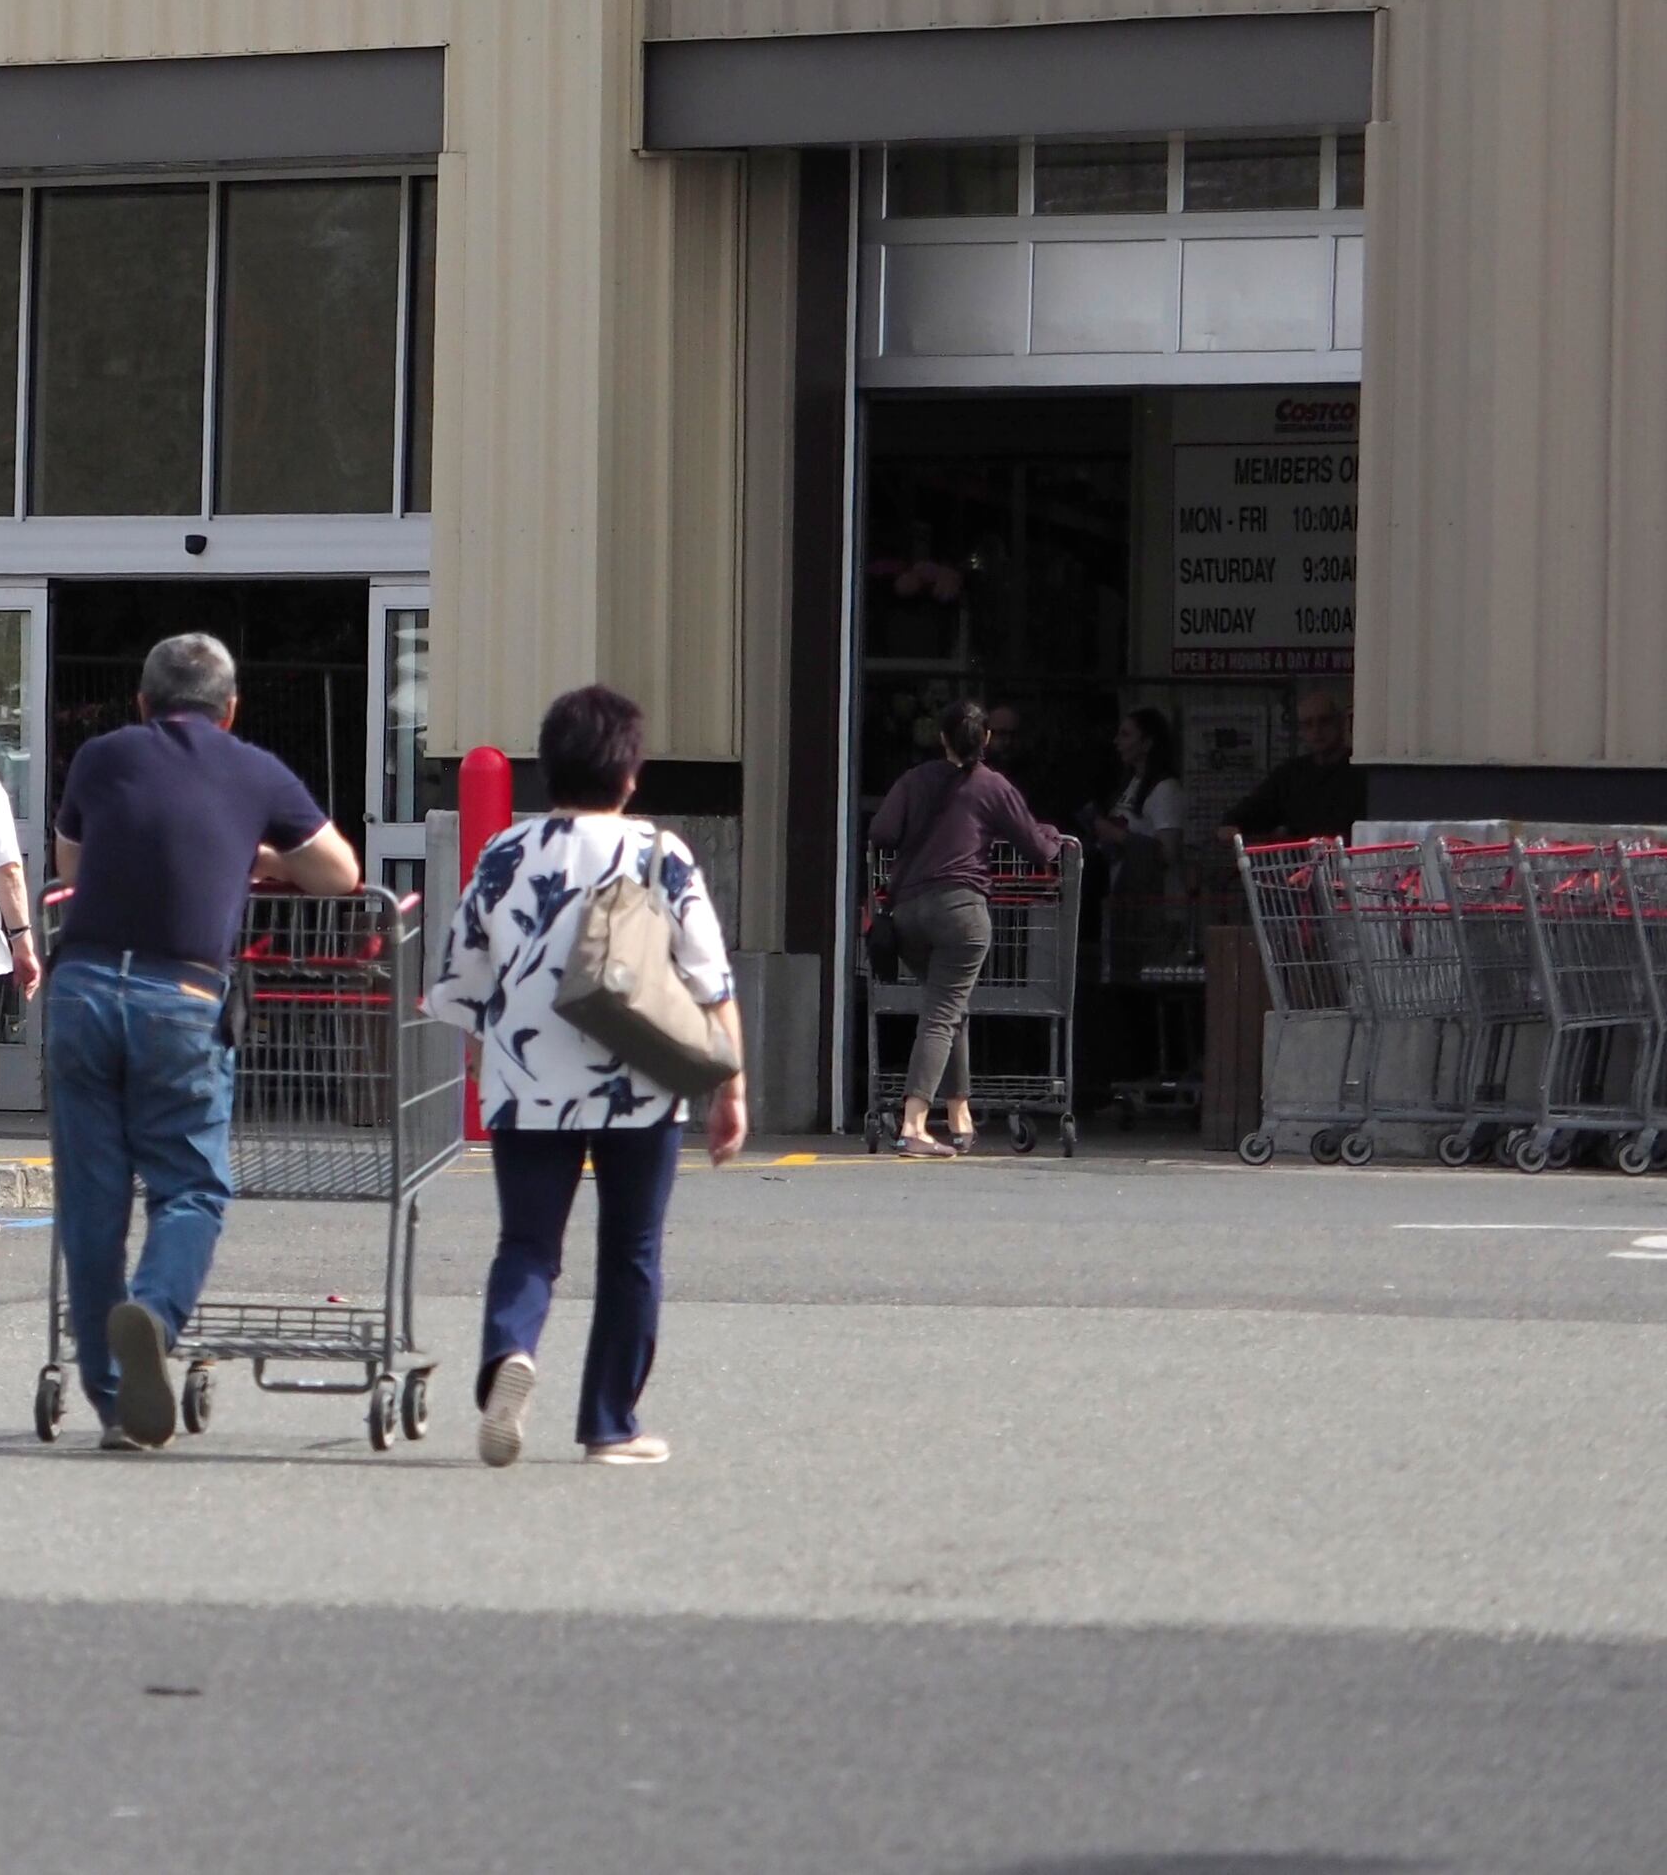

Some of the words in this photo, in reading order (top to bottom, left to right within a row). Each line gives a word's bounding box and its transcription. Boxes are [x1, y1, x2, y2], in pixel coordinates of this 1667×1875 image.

[1275, 398, 1356, 422] COSTCO
[1234, 456, 1333, 485] MEMBERS
[1179, 507, 1222, 533] MON
[1239, 506, 1267, 533] FRI
[1179, 557, 1276, 584] SATURDAY
[1303, 556, 1357, 583] 9:30A
[1179, 607, 1256, 635] SUNDAY
[1294, 606, 1356, 634] 10:00A
[1174, 652, 1206, 670] OPEN
[1229, 652, 1271, 670] HOURS
